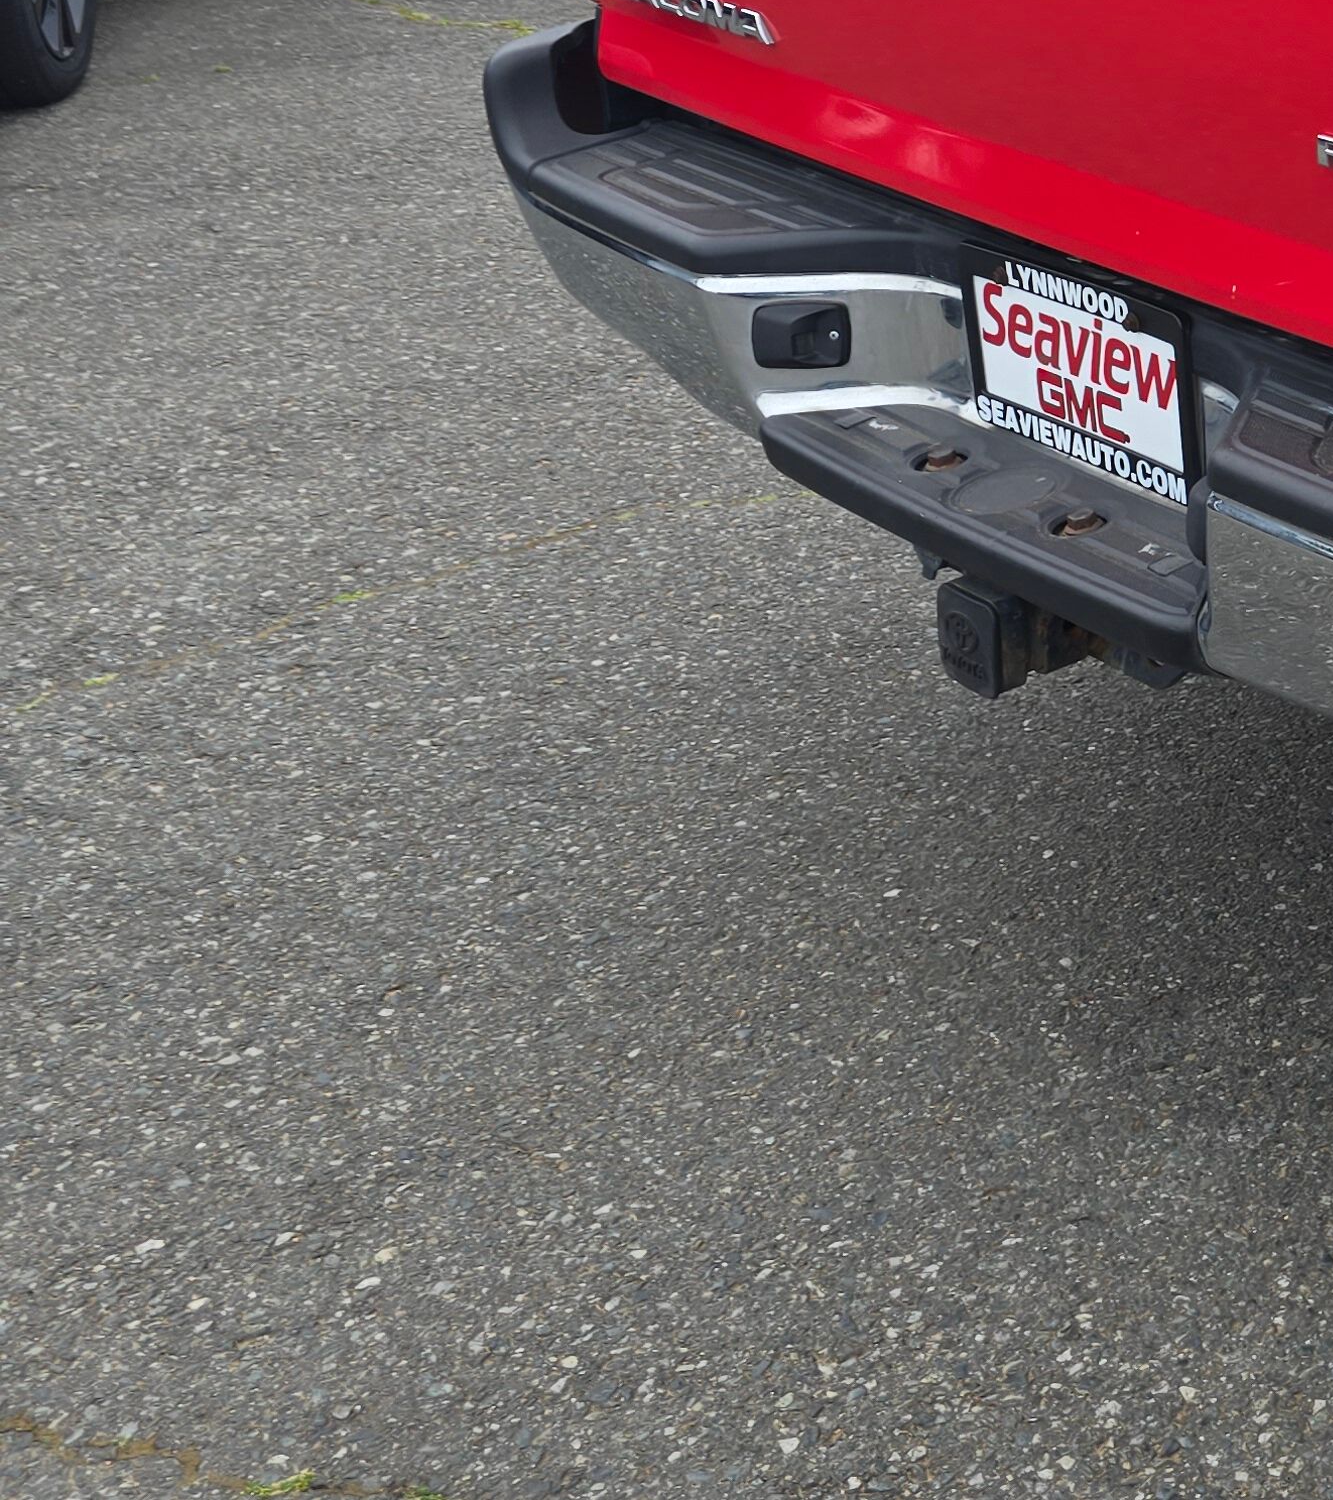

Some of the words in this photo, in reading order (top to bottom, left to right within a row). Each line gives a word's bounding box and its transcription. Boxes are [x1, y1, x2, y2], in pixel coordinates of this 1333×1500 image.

[1004, 261, 1128, 322] LYNNWOOD
[982, 282, 1177, 411] Seaview
[976, 394, 1188, 505] SEAVIEWAUTO.COM
[1036, 367, 1130, 444] GMC
